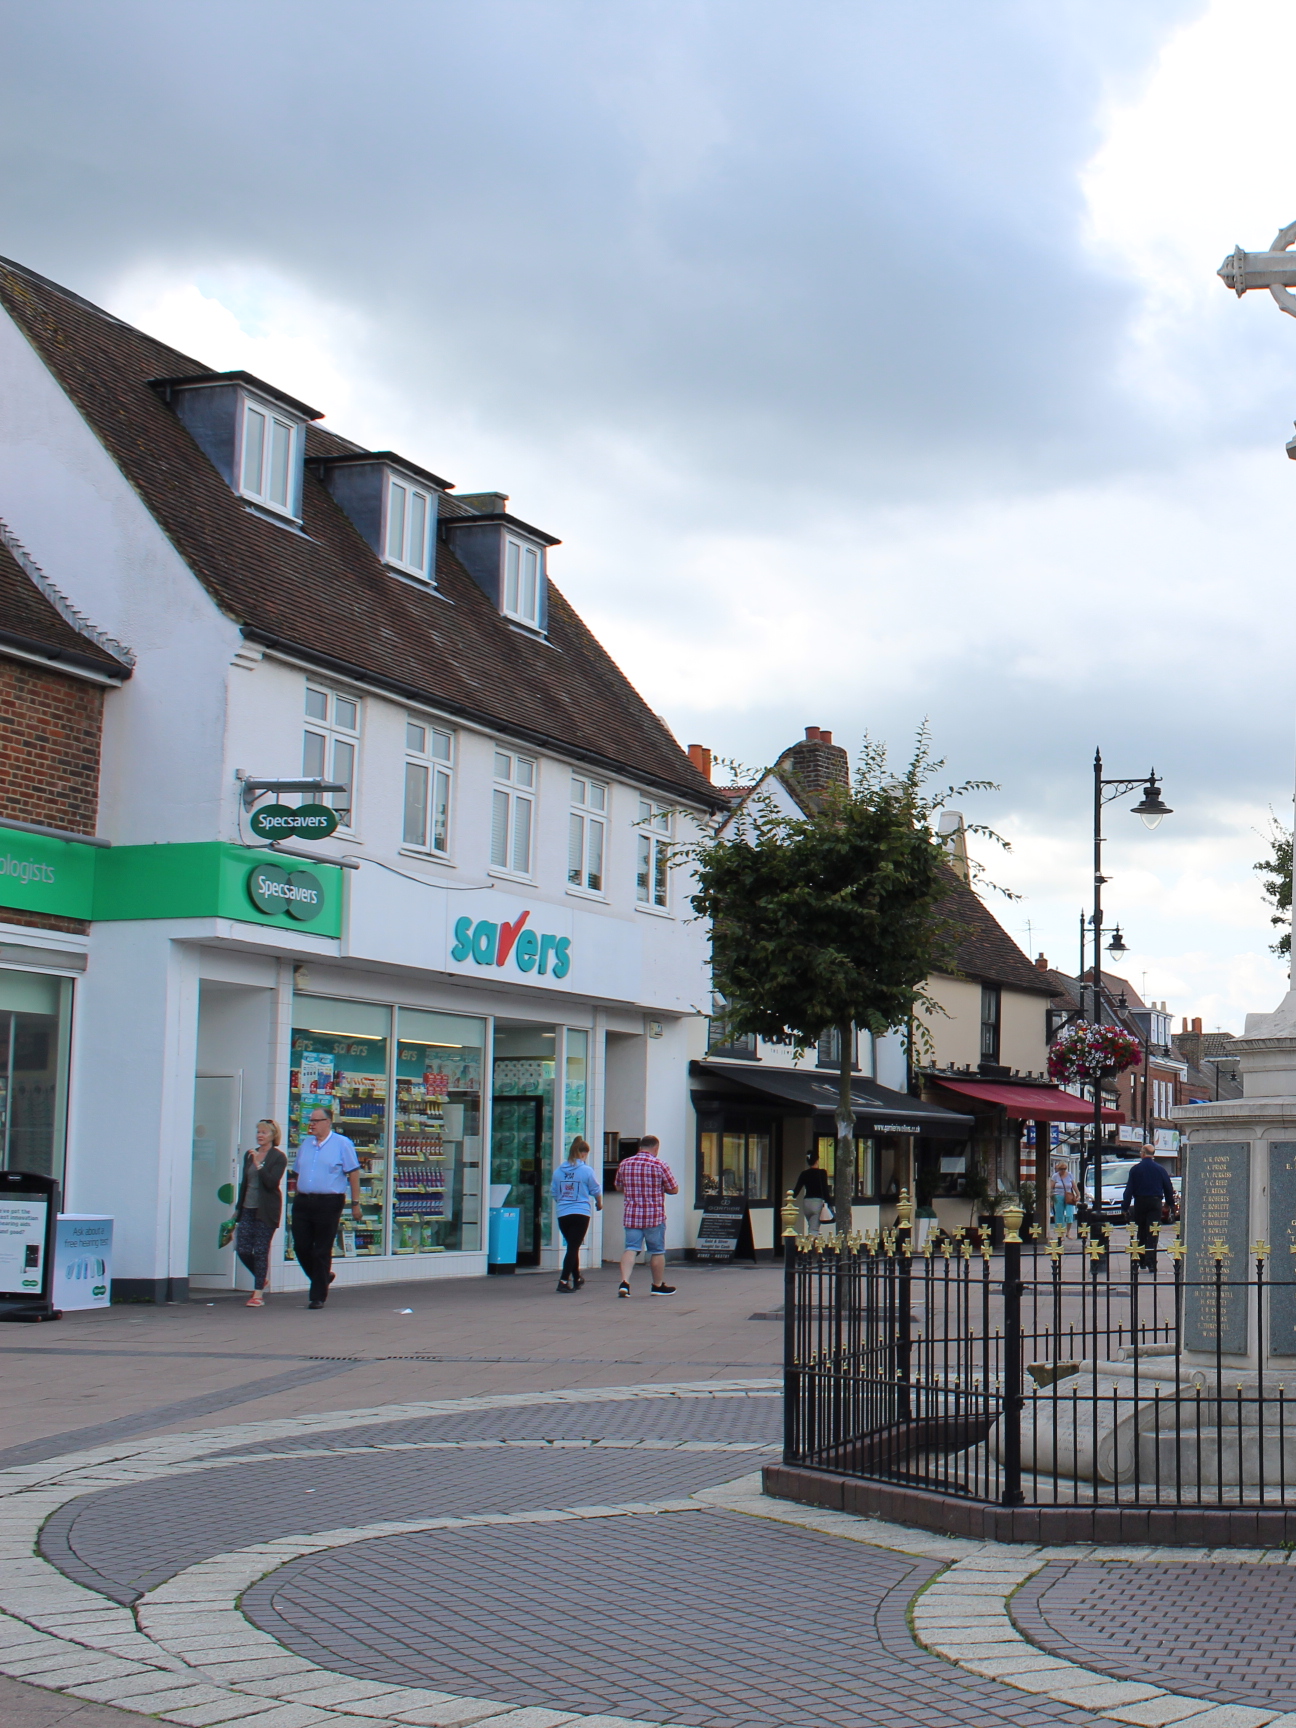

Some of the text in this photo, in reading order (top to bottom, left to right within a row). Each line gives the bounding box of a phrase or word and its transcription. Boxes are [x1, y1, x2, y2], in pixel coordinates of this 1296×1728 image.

[258, 814, 327, 830] Specsavers
[258, 876, 318, 904] Specsavers
[451, 910, 571, 978] savers
[73, 1227, 84, 1236] Ask
[65, 1239, 78, 1247] free
[79, 1239, 99, 1248] hearing
